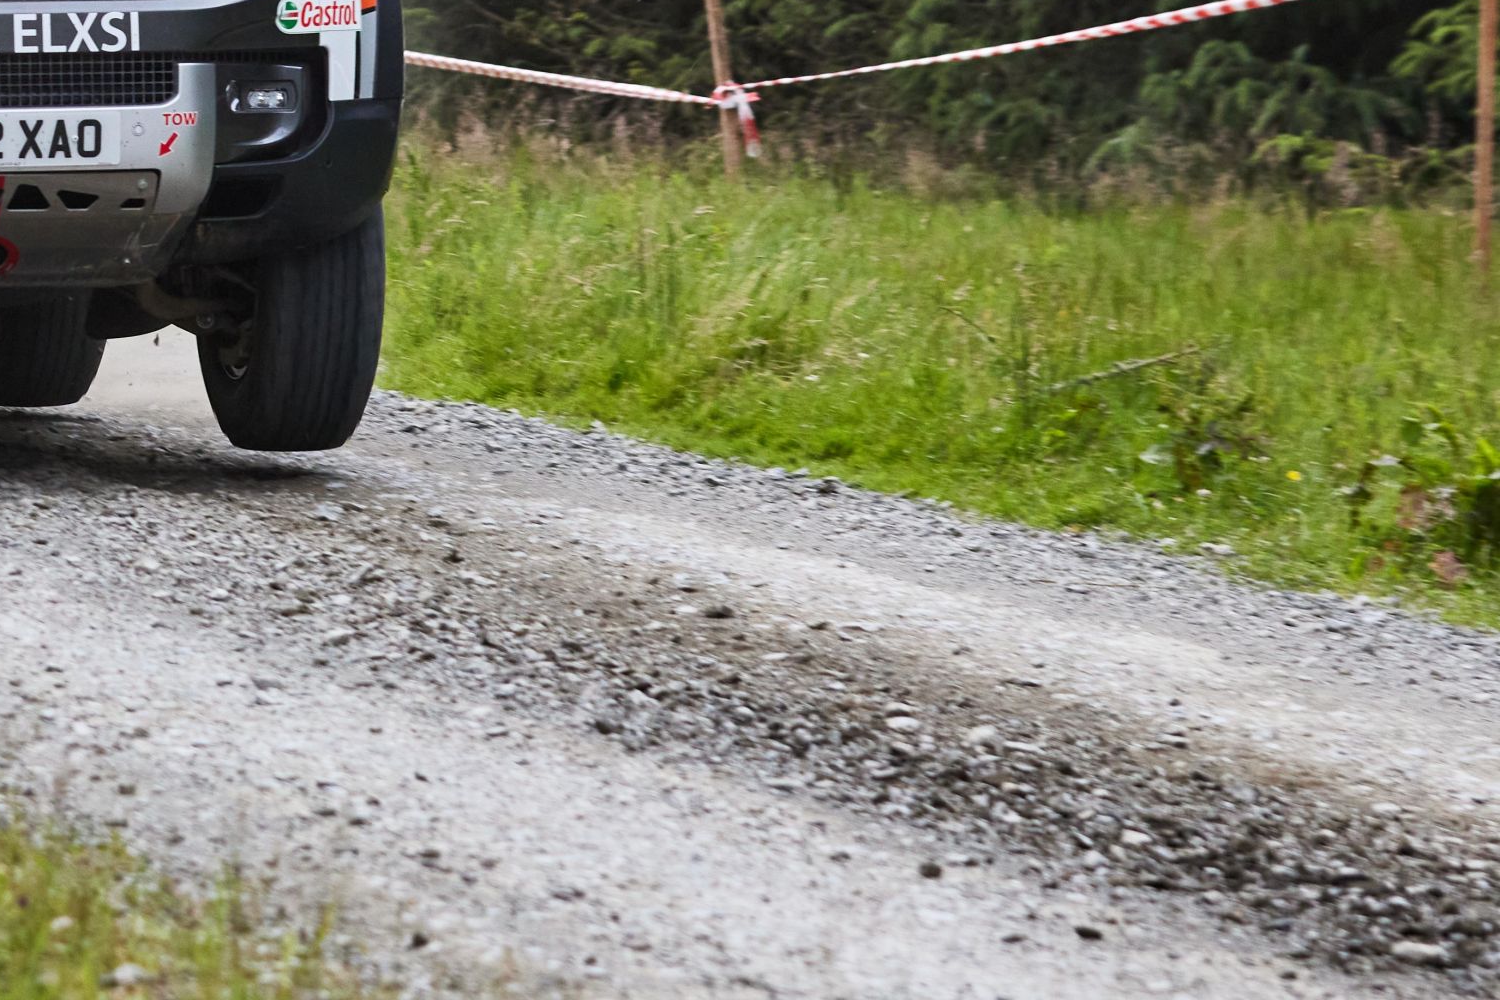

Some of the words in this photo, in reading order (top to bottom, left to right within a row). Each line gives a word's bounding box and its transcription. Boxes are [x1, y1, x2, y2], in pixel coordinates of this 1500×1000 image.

[301, 0, 357, 28] Castrol
[13, 11, 140, 54] ELXSI
[162, 112, 198, 127] TOW
